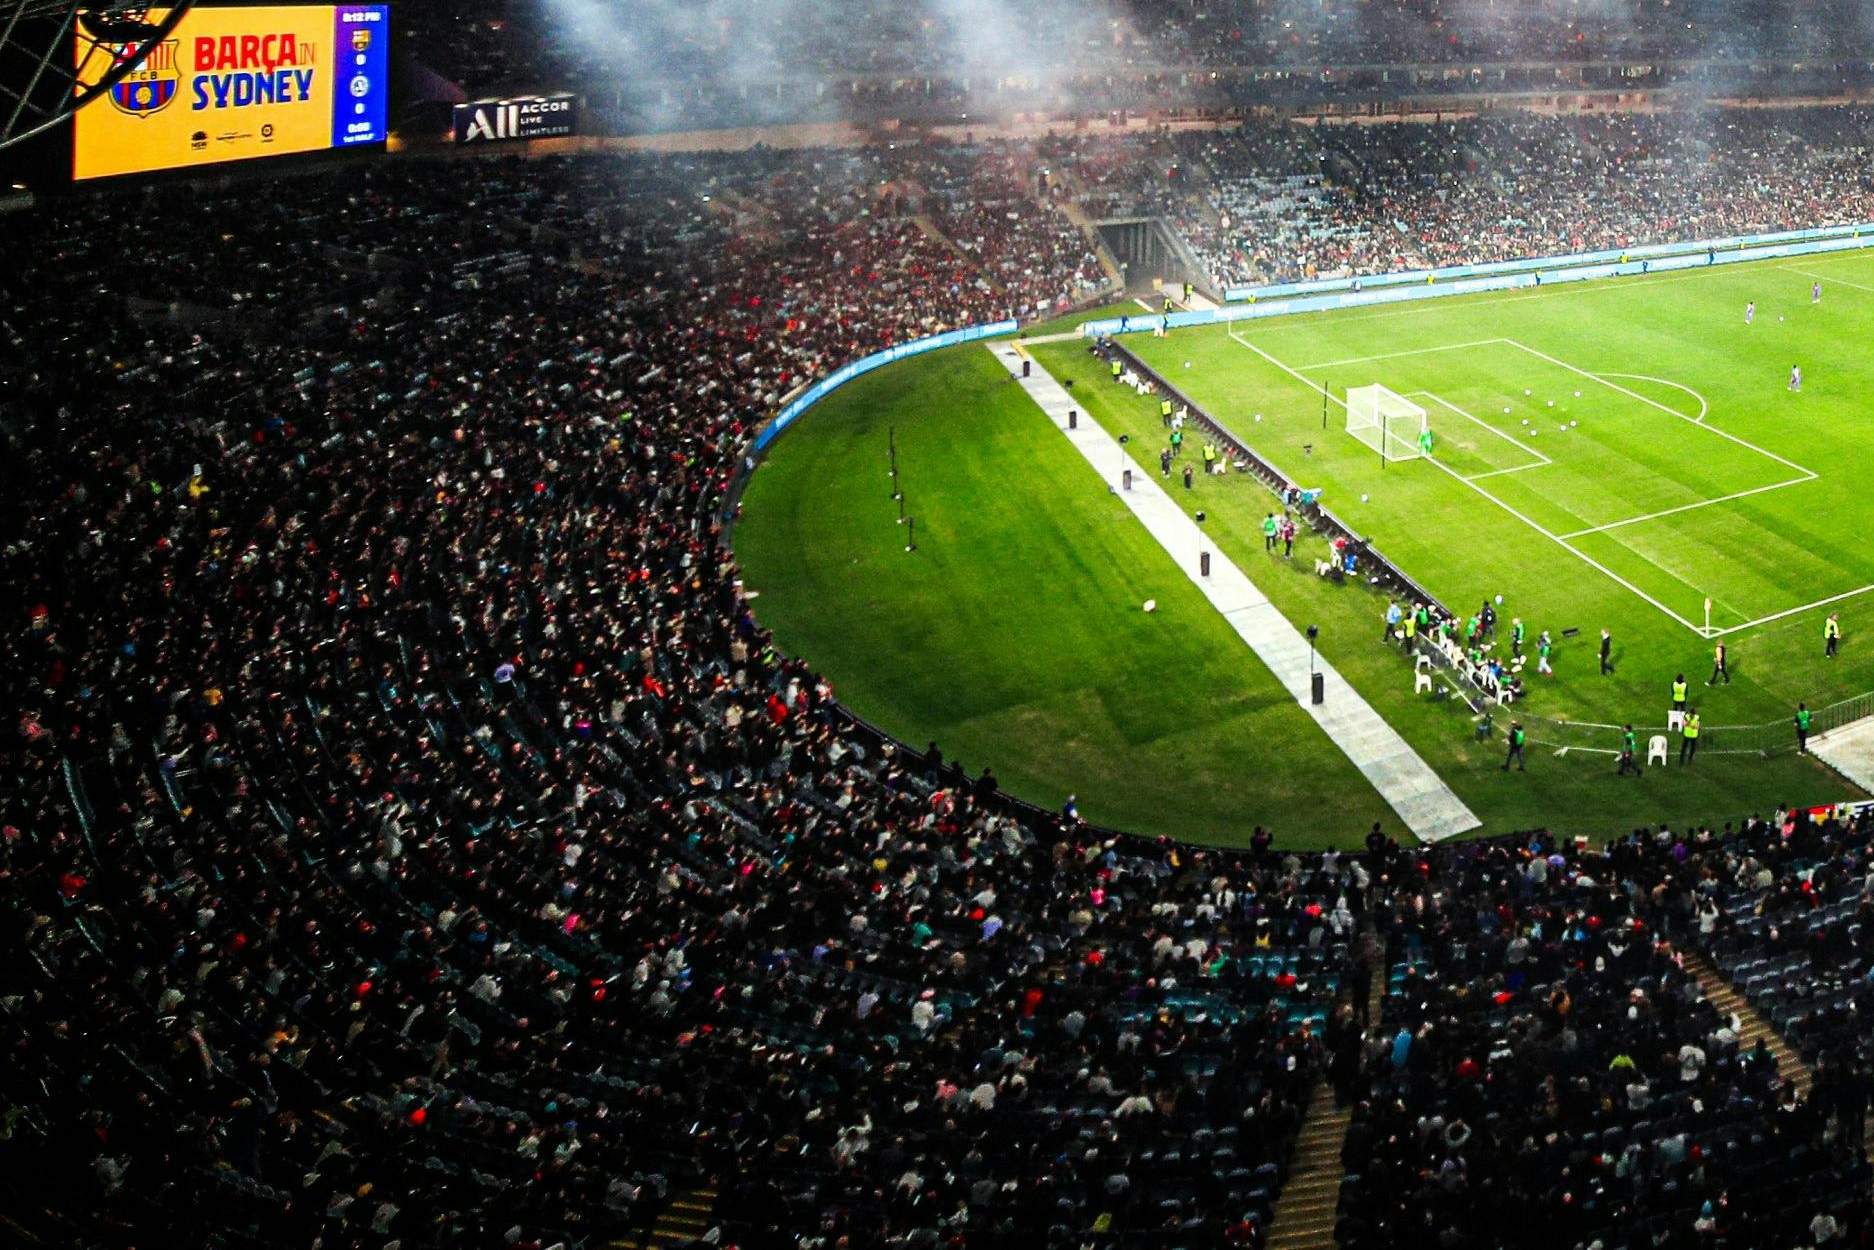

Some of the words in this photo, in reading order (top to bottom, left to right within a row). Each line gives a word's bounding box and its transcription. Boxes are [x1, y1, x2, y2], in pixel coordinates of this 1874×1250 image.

[194, 33, 298, 75] BARÇA
[299, 41, 317, 65] IN
[130, 71, 157, 82] FCB
[192, 68, 314, 111] SYDNEY
[520, 101, 570, 114] ACCOR
[520, 116, 543, 125] LIVE
